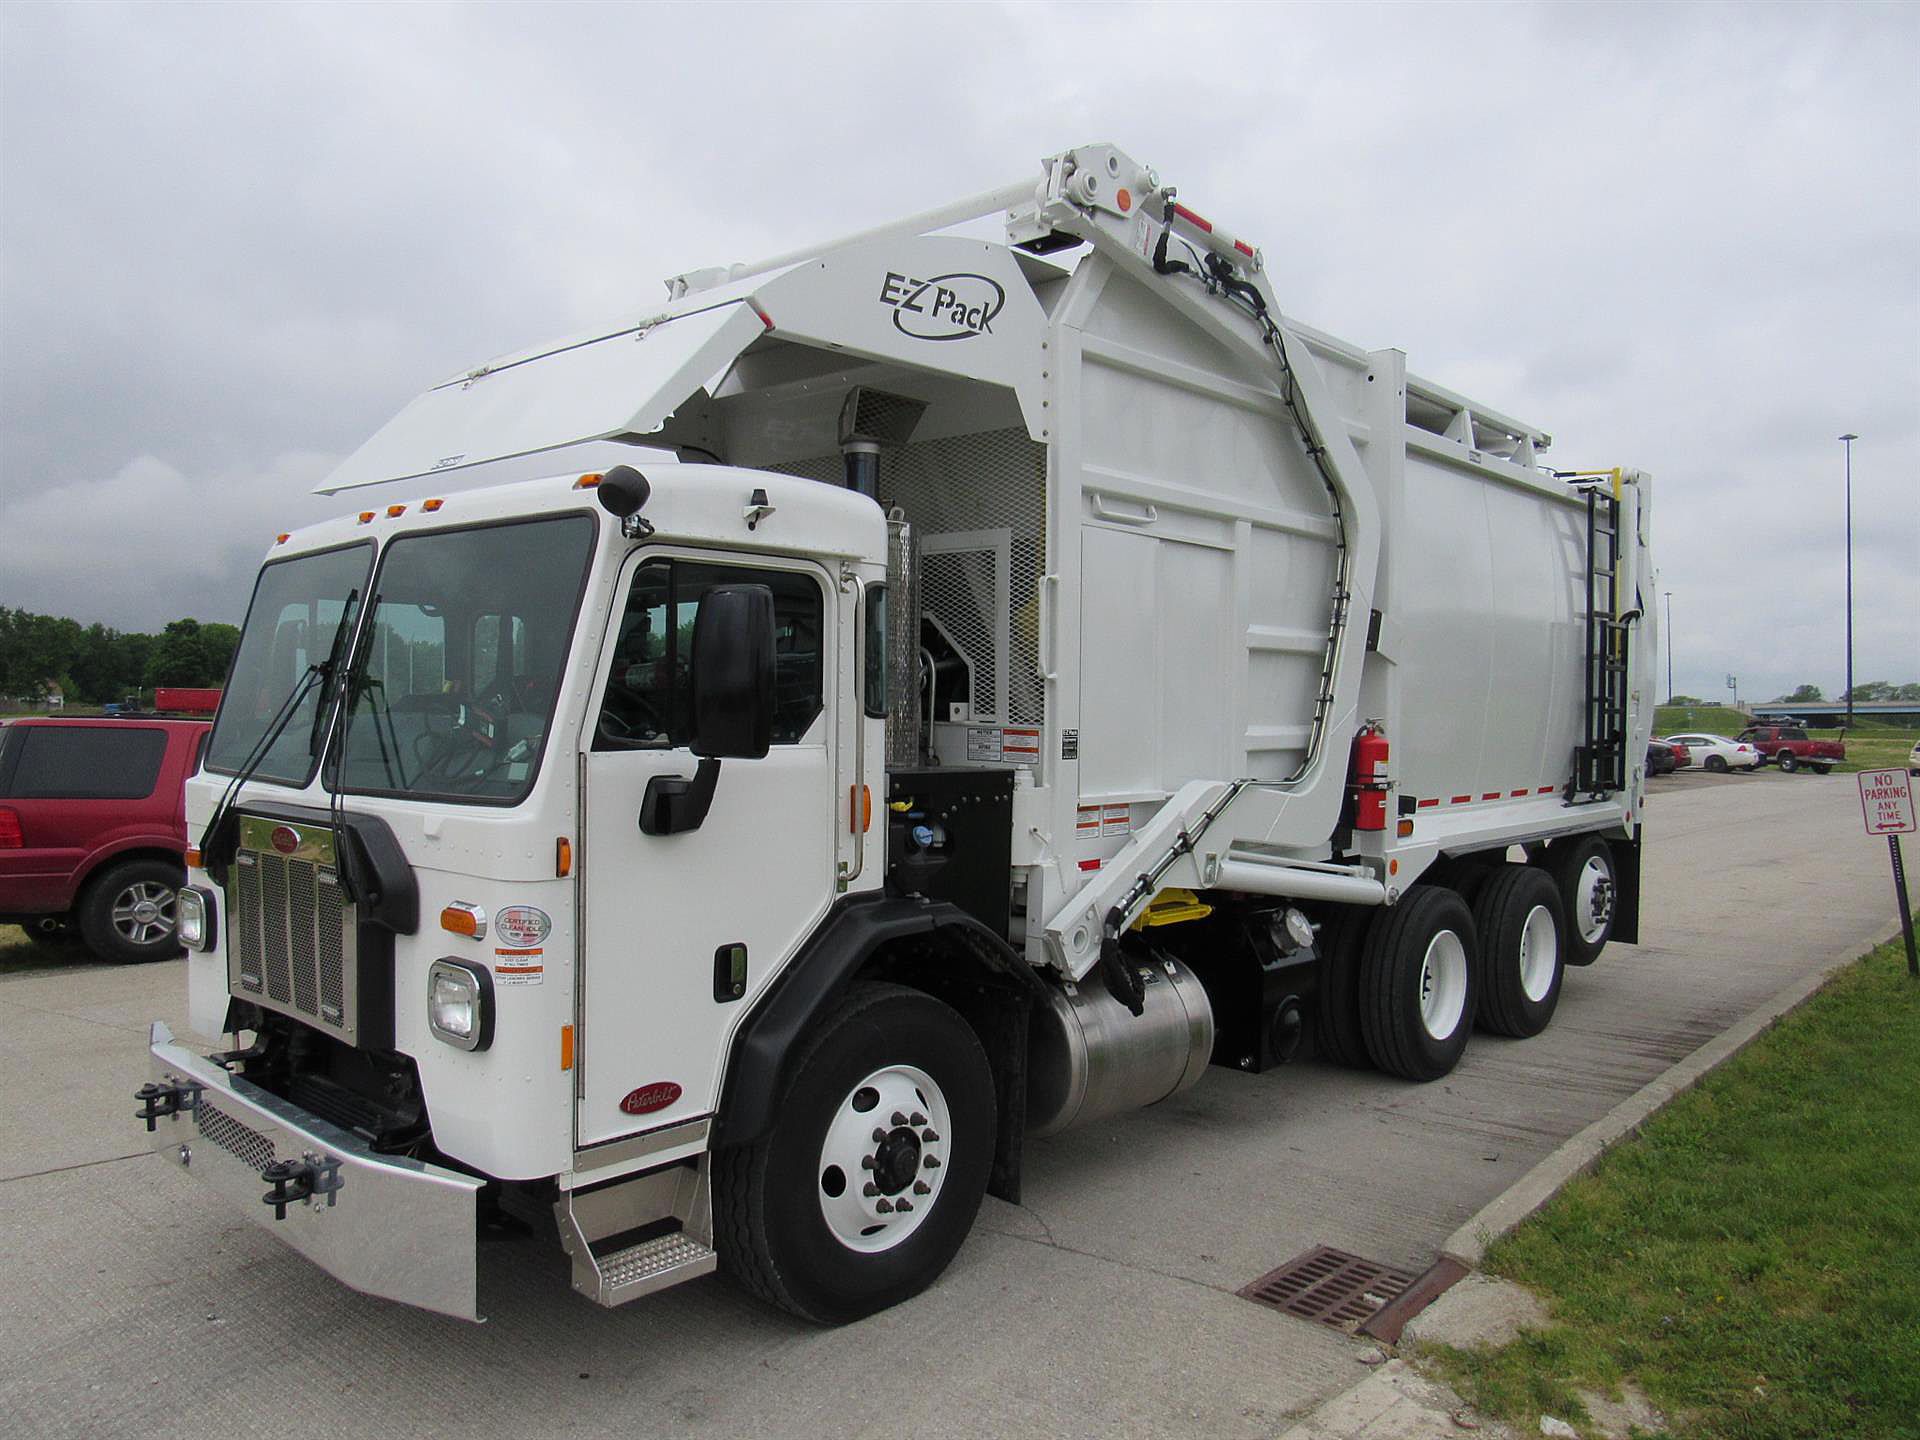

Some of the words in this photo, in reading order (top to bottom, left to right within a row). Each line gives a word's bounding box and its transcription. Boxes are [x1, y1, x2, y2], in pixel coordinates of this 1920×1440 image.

[932, 286, 993, 334] Pack
[1874, 775, 1892, 786] NO
[1865, 786, 1907, 800] PARKING
[1878, 801, 1897, 811] ANY
[1877, 810, 1902, 821] TIME
[626, 1085, 678, 1112] Peterbilt
